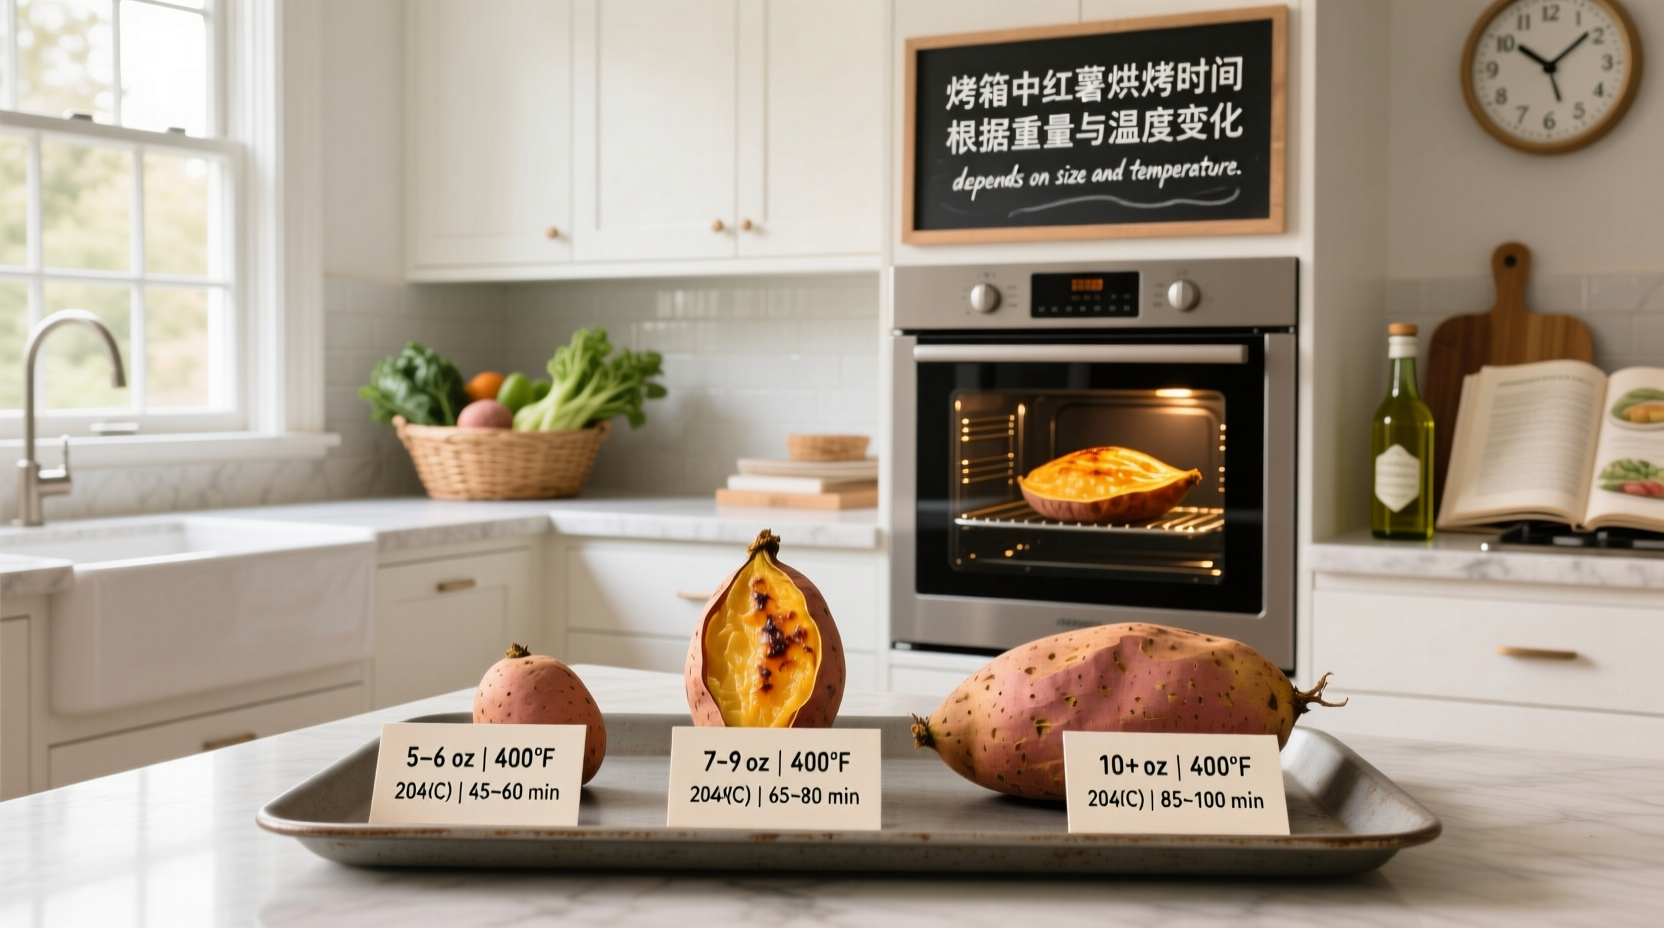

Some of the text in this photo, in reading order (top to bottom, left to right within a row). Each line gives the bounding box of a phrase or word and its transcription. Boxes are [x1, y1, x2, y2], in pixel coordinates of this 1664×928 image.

[1517, 14, 1531, 31] 11
[1542, 5, 1560, 22] 12
[1575, 11, 1582, 26] 1
[1497, 34, 1515, 53] 10
[1592, 28, 1604, 45] 2
[1486, 61, 1499, 79] 9
[1602, 54, 1613, 71] 3
[946, 56, 1243, 111] 烤箱中红薯烘烤时间
[1593, 82, 1604, 98] 4
[1495, 87, 1508, 105] 8
[1516, 106, 1529, 125] 7
[1573, 103, 1585, 120] 5
[946, 102, 1243, 155] 根据重量与温度变化
[1543, 112, 1556, 130] 6
[952, 156, 1242, 201] depends on size and temperature.
[452, 752, 475, 768] oz
[746, 757, 770, 772] oz
[1099, 754, 1139, 775] 10+
[1144, 760, 1168, 776] oz
[395, 781, 452, 802] 204(C)
[528, 783, 560, 801] min
[828, 787, 860, 805] min
[1088, 789, 1144, 811] 204(C)
[1231, 791, 1264, 809] min
